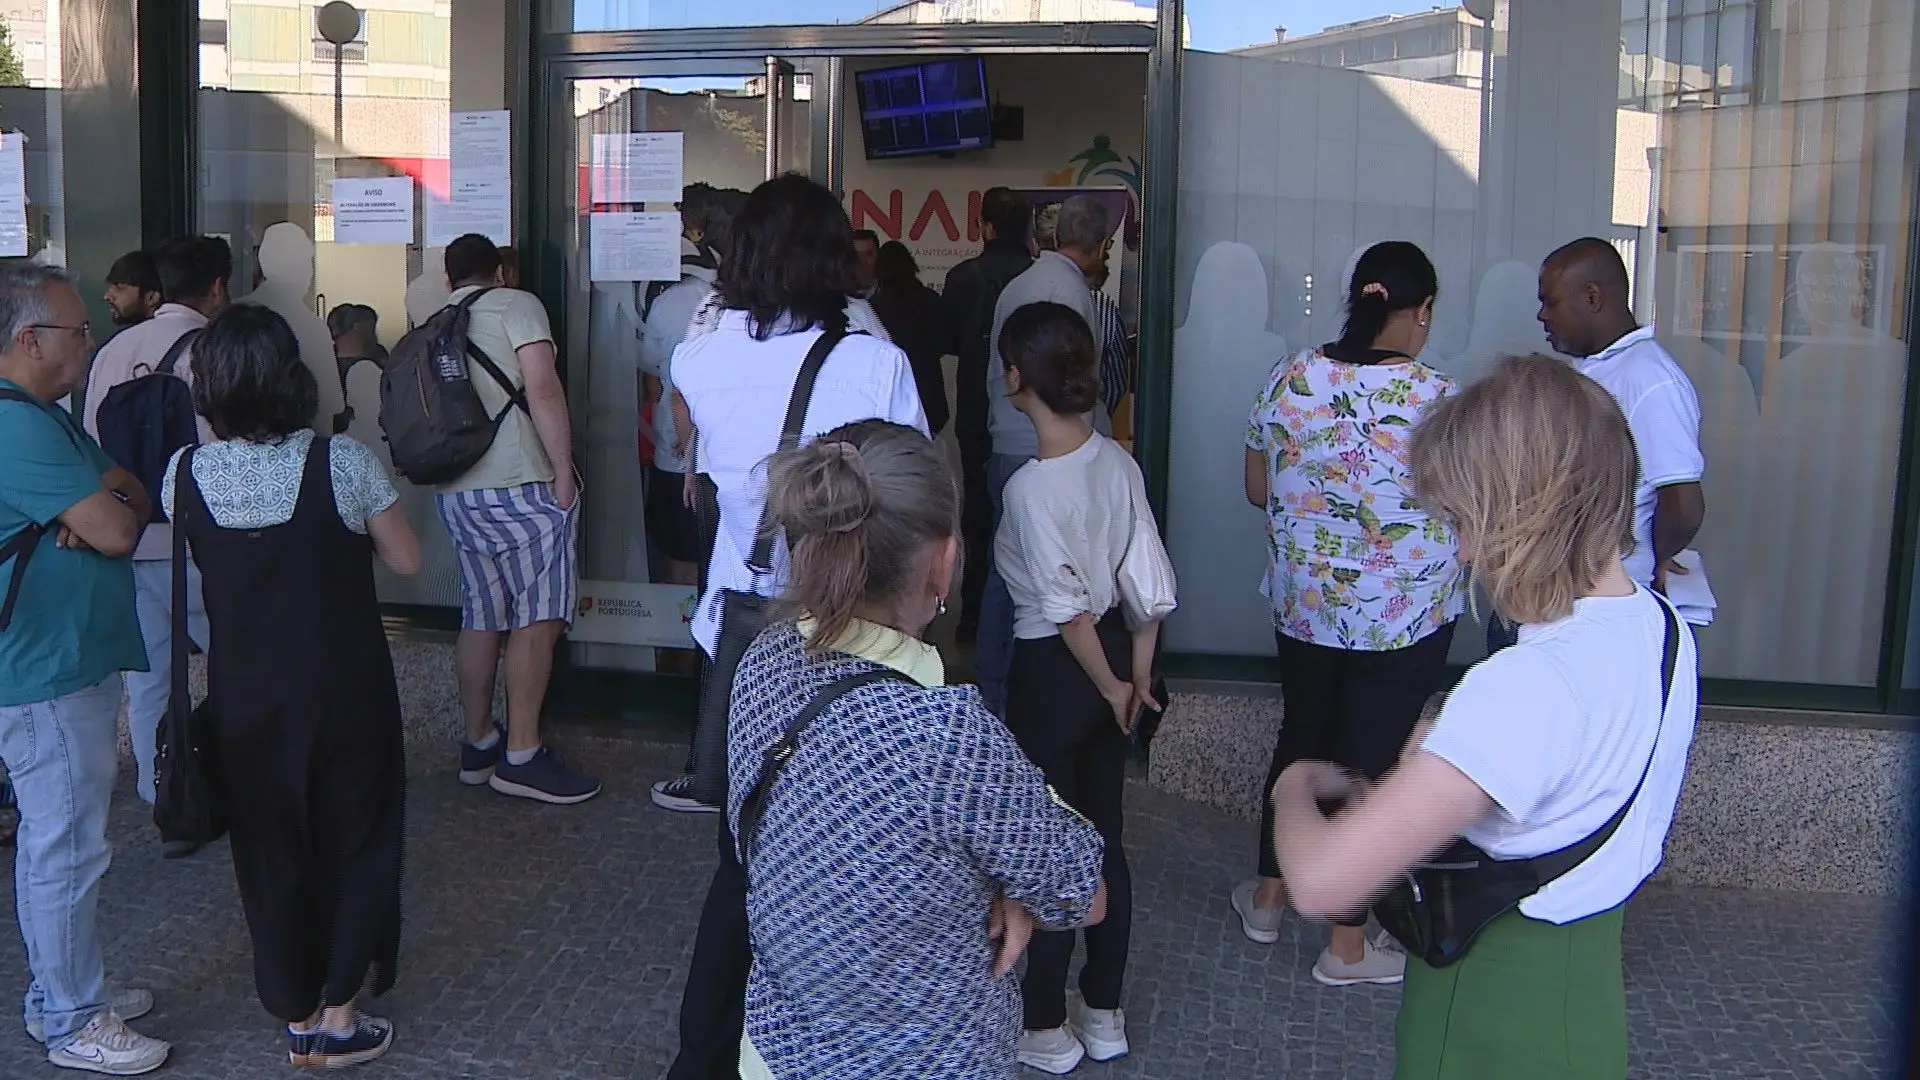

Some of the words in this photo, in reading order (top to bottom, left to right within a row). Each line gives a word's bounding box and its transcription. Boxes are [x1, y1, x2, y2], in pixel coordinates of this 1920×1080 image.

[364, 188, 384, 197] AVISO
[842, 189, 983, 242] NAI
[598, 607, 653, 618] PORTUGUESA
